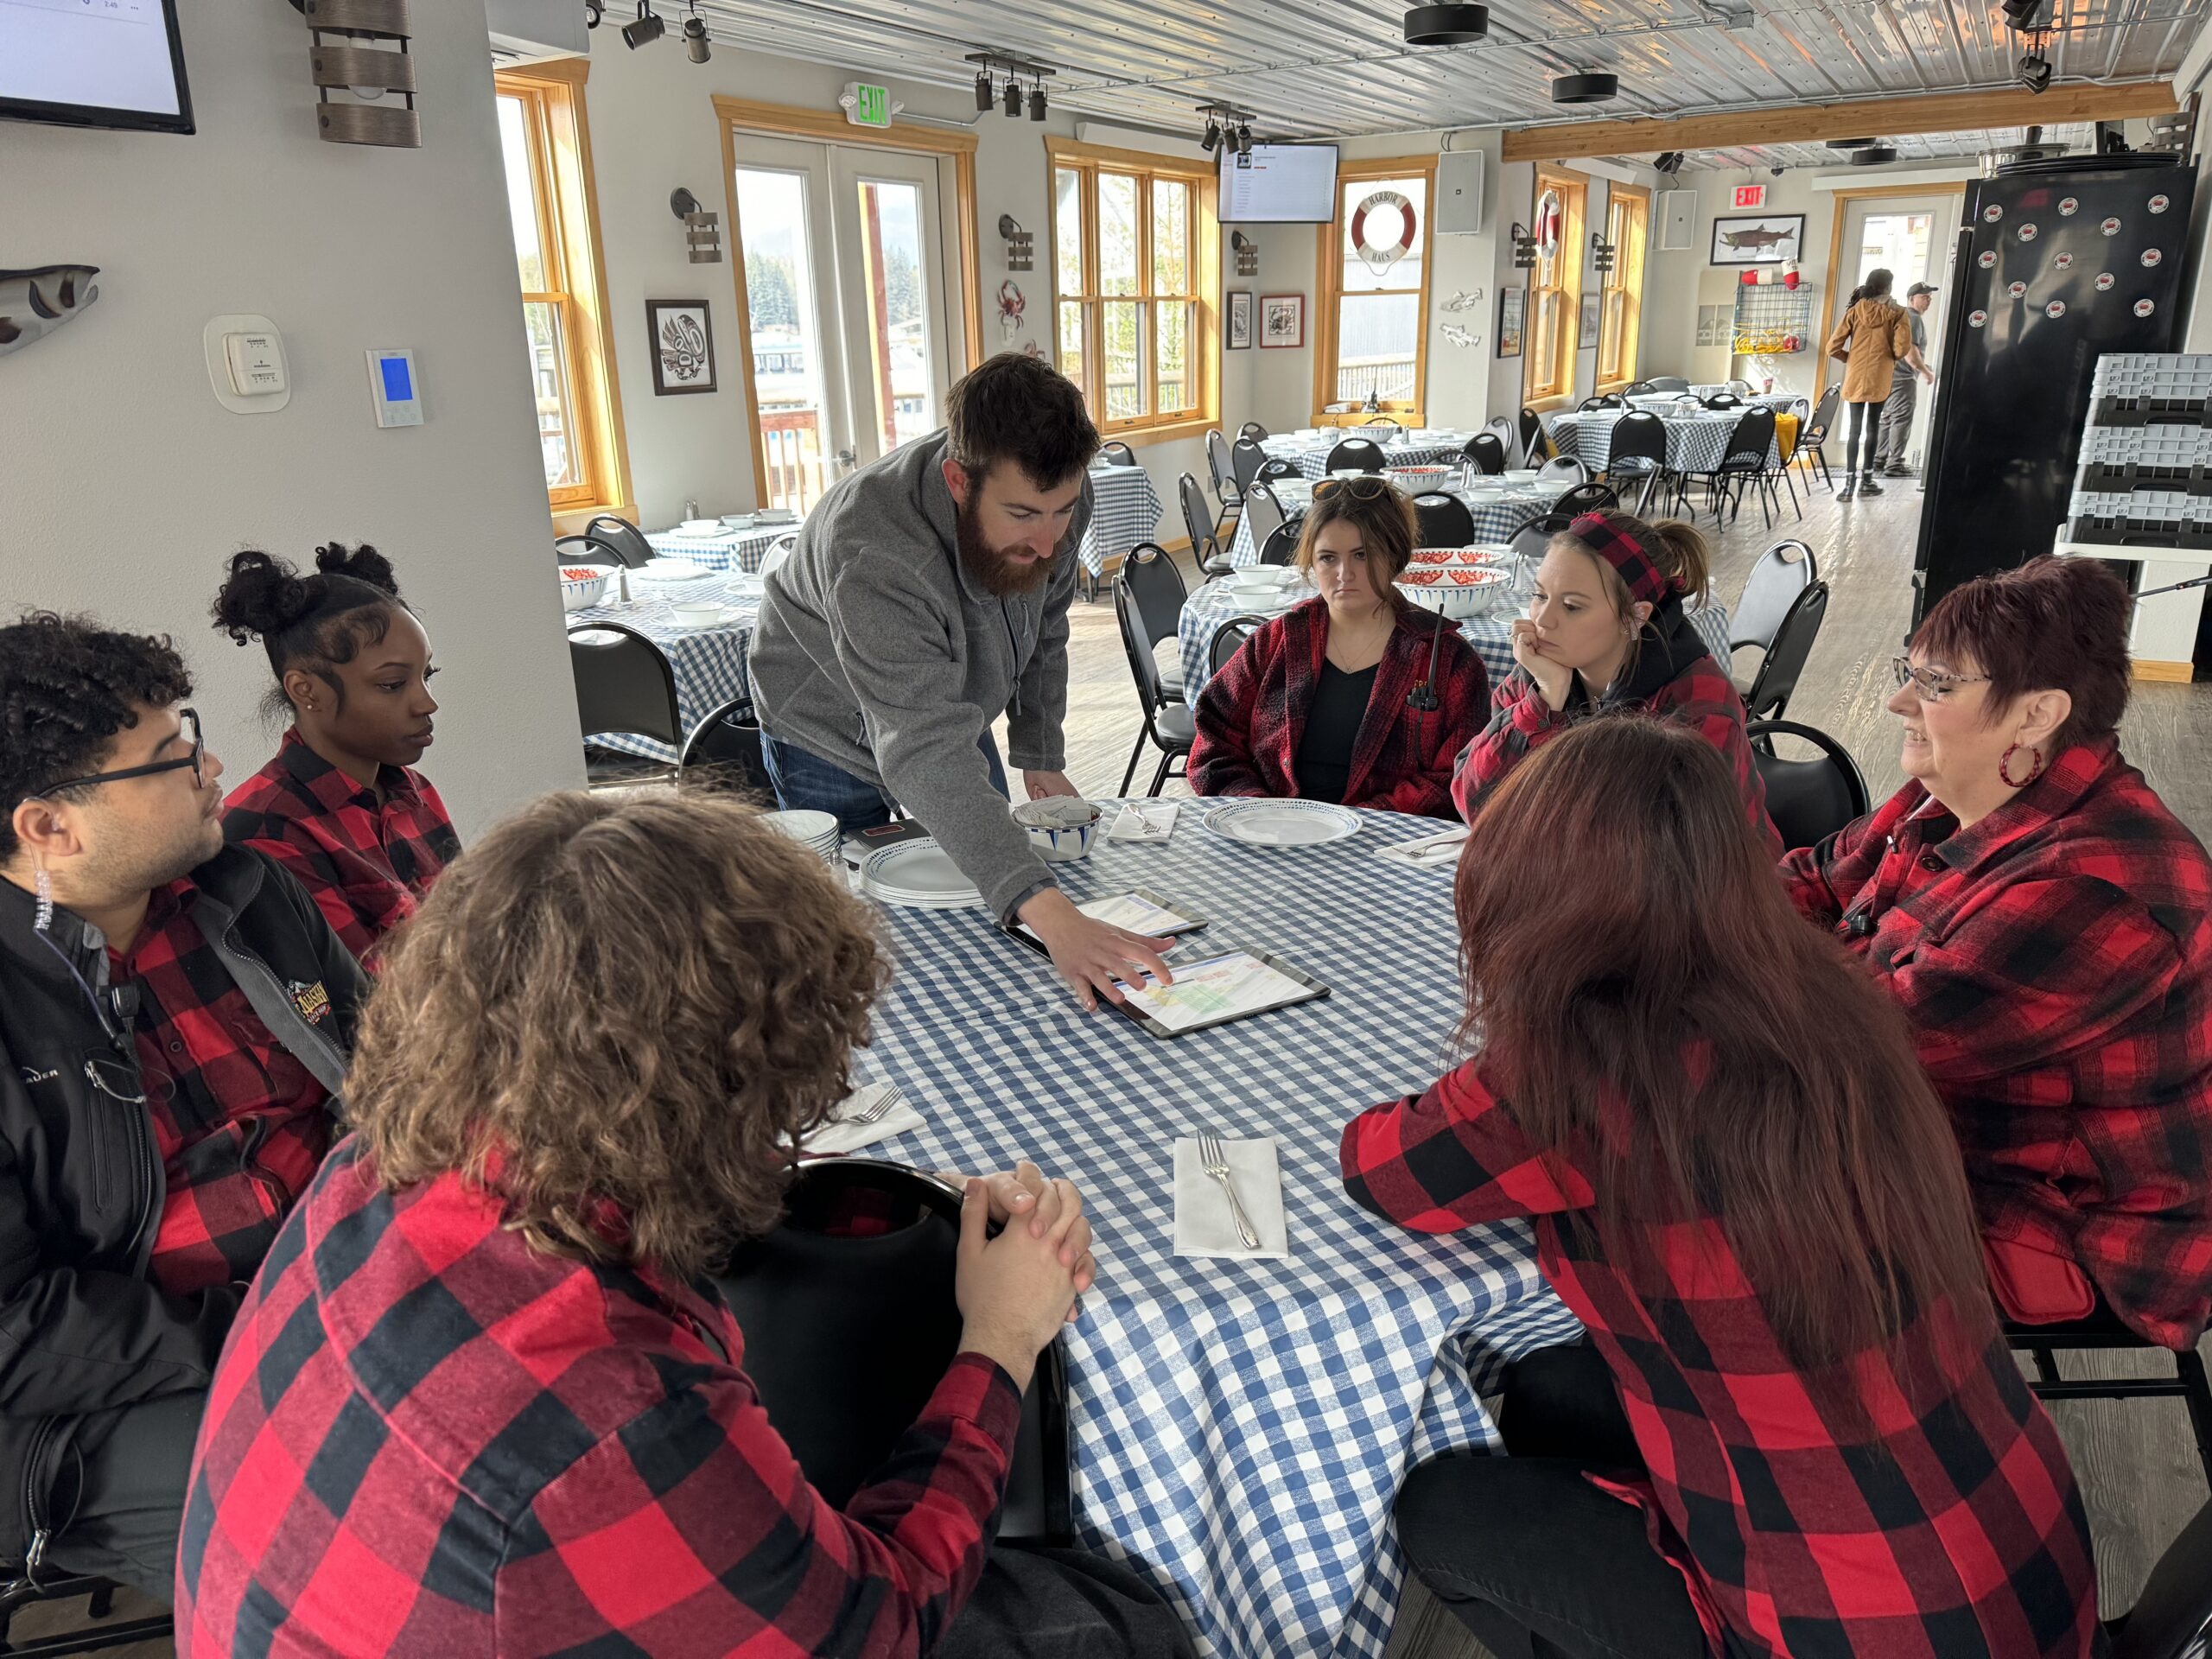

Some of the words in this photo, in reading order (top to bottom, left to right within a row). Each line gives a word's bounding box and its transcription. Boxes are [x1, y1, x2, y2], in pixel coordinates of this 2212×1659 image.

[858, 85, 886, 124] EXIT
[1368, 191, 1398, 206] HARBOR
[1736, 186, 1762, 207] EXIT
[1372, 251, 1389, 263] HAUS
